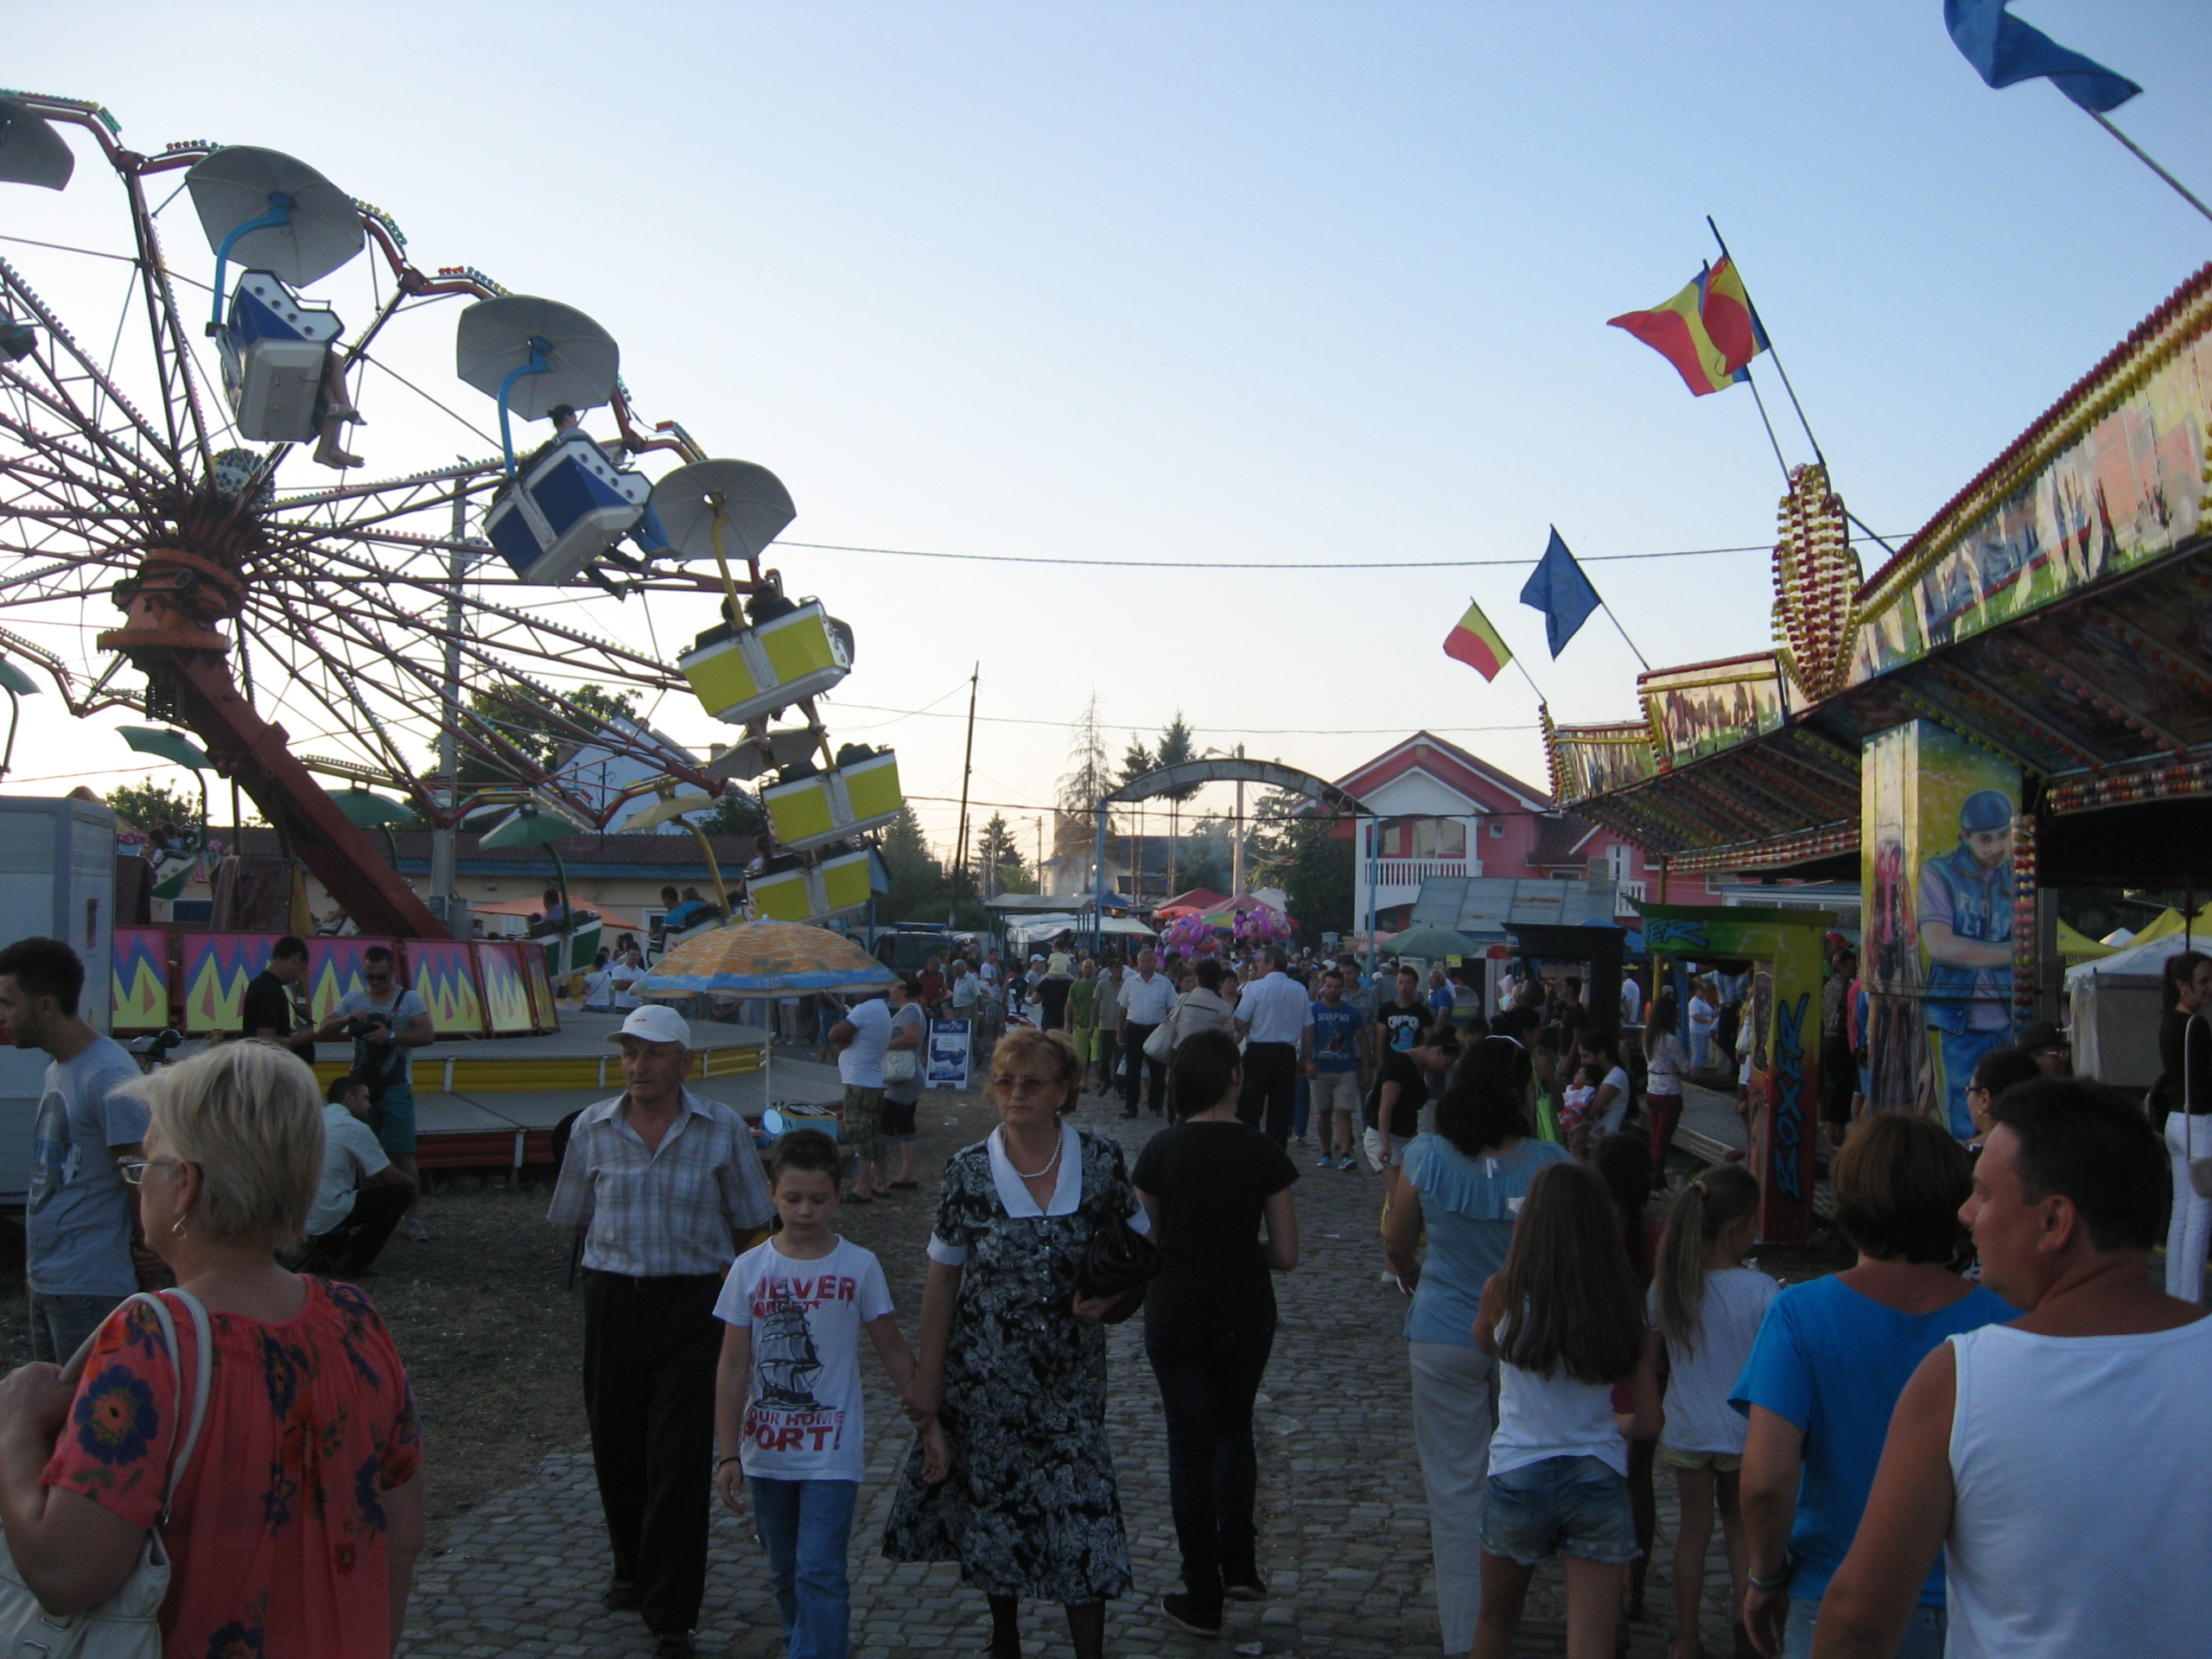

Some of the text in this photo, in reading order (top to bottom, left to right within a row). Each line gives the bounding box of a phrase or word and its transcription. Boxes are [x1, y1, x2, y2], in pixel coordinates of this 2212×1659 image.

[1772, 992, 1811, 1206] BOXER
[785, 1410, 844, 1426] HOME
[741, 1419, 842, 1452] PORT!
